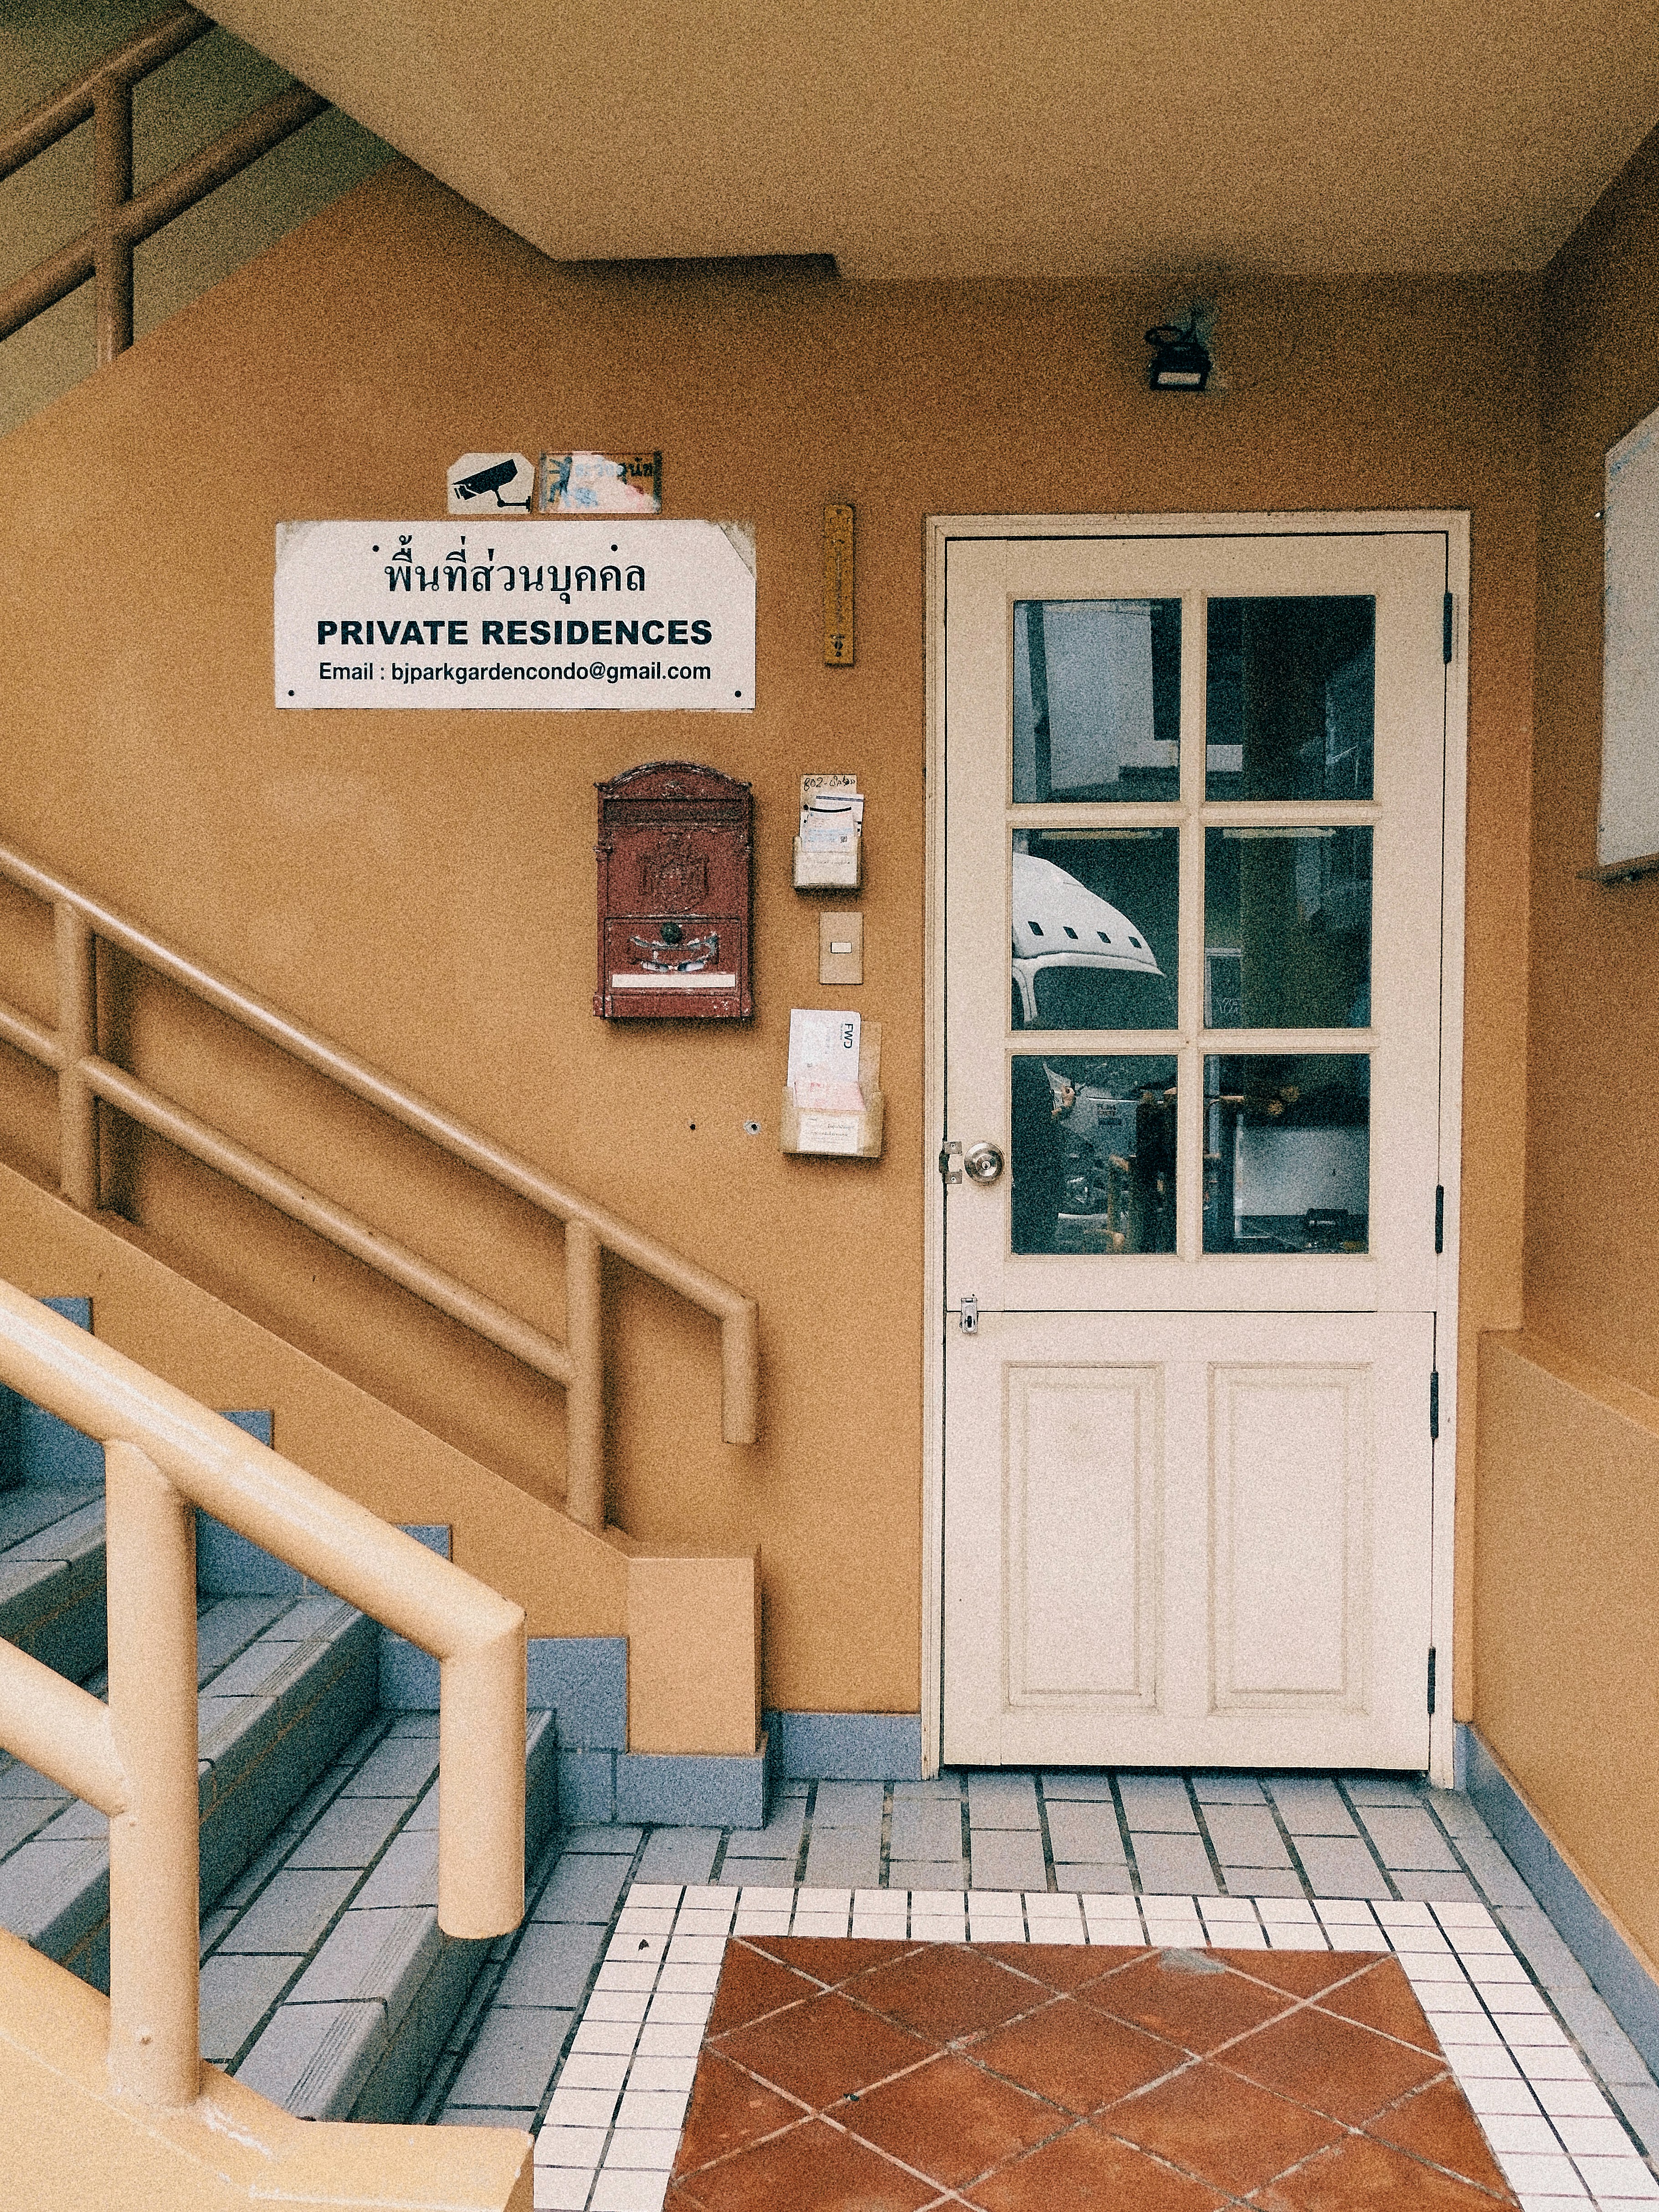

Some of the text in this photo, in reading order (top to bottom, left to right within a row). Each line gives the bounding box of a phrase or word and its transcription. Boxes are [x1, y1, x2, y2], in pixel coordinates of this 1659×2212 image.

[384, 535, 647, 604] พื้นที่ส่วนบุคคล
[318, 620, 712, 645] PRIVATE RESIDENCES
[319, 662, 373, 680] Email
[391, 661, 711, 684] bjparkgardencondo@gmail.com
[843, 1023, 853, 1049] FWD
